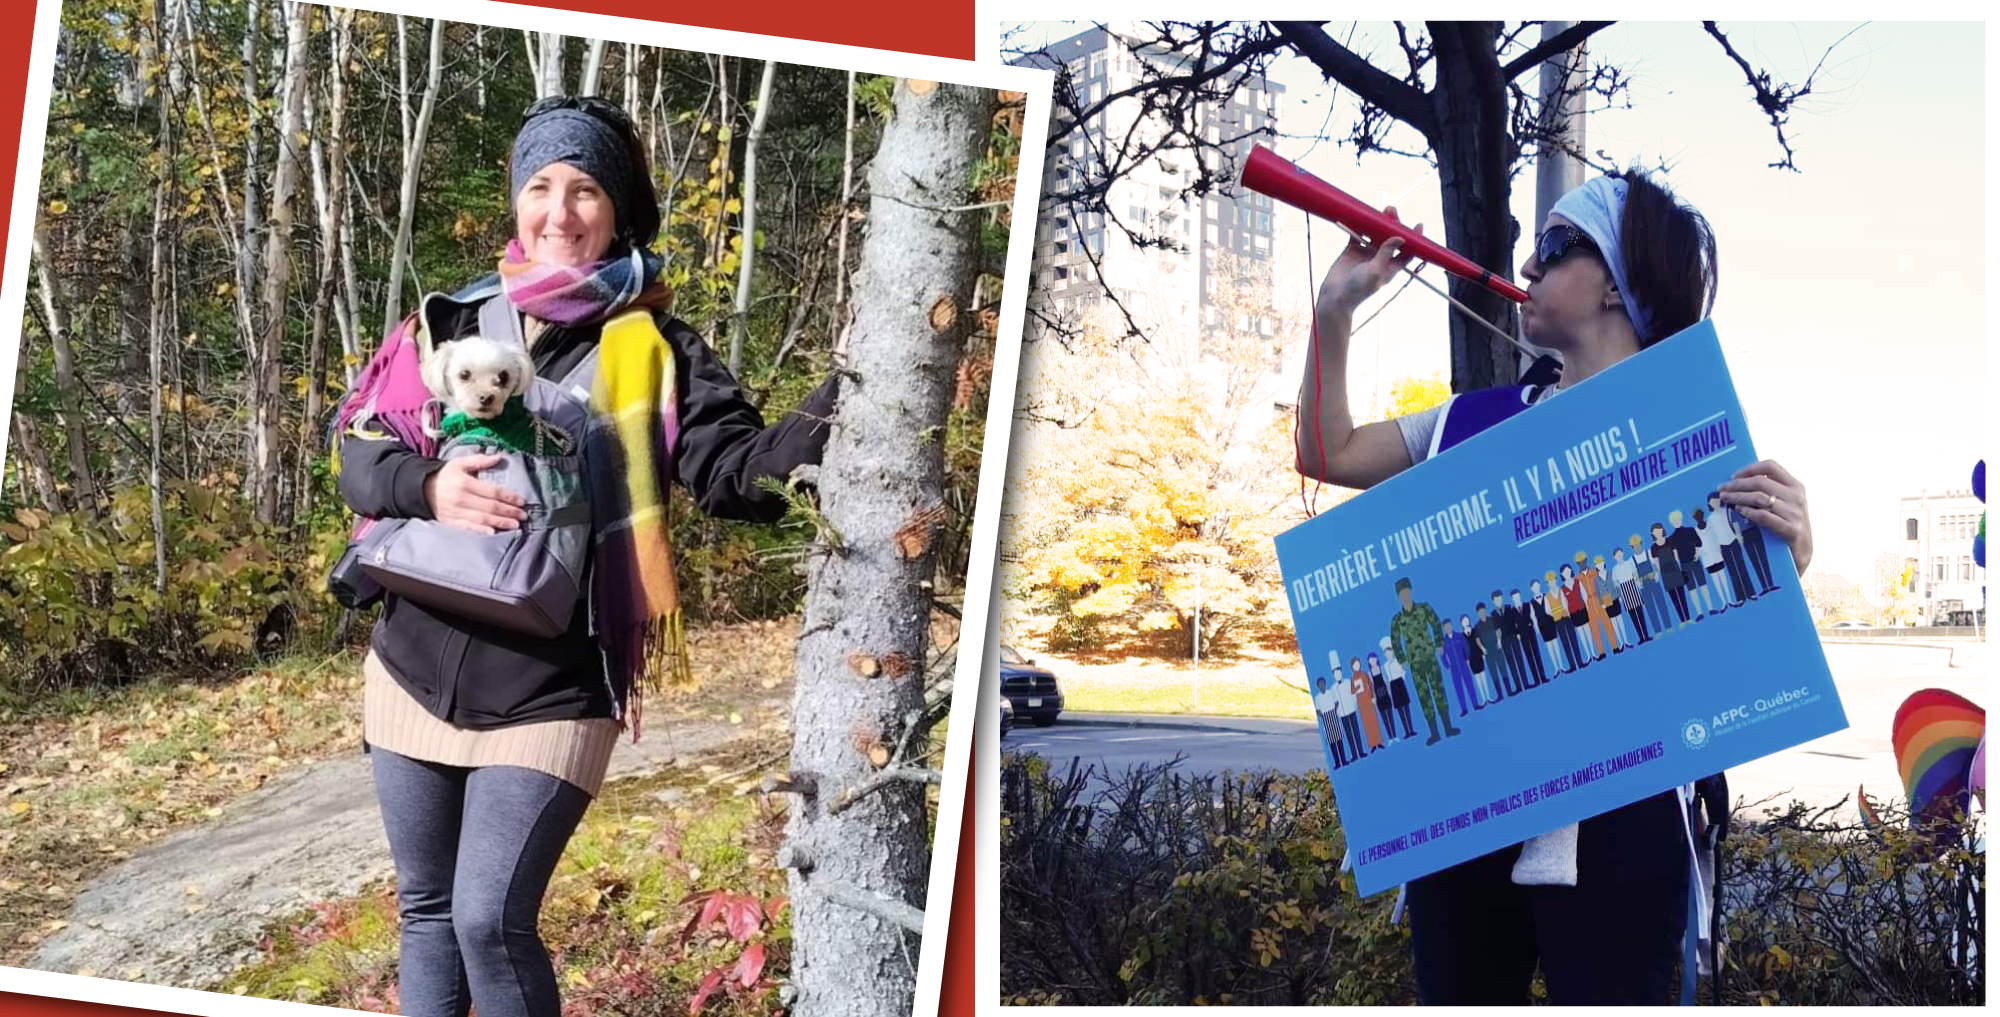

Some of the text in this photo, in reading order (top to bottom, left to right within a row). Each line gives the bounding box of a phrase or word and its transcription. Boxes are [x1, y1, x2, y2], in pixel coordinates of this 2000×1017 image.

[1292, 543, 1381, 613] DERRIÈRE
[1502, 475, 1527, 514] IL
[1525, 464, 1542, 501] Y
[1547, 457, 1566, 494] A
[1564, 425, 1628, 484] NOUS
[1513, 418, 1735, 542] RECONNAISSEZ NOTRE TRAVAIL
[1712, 704, 1749, 729] AFPC
[1754, 686, 1809, 711] Québec
[1358, 740, 1664, 866] LE PERSONNEL CIVIL DES FONDS NON PUBLICS DES FORCES ARMÉES CANADIENNES
